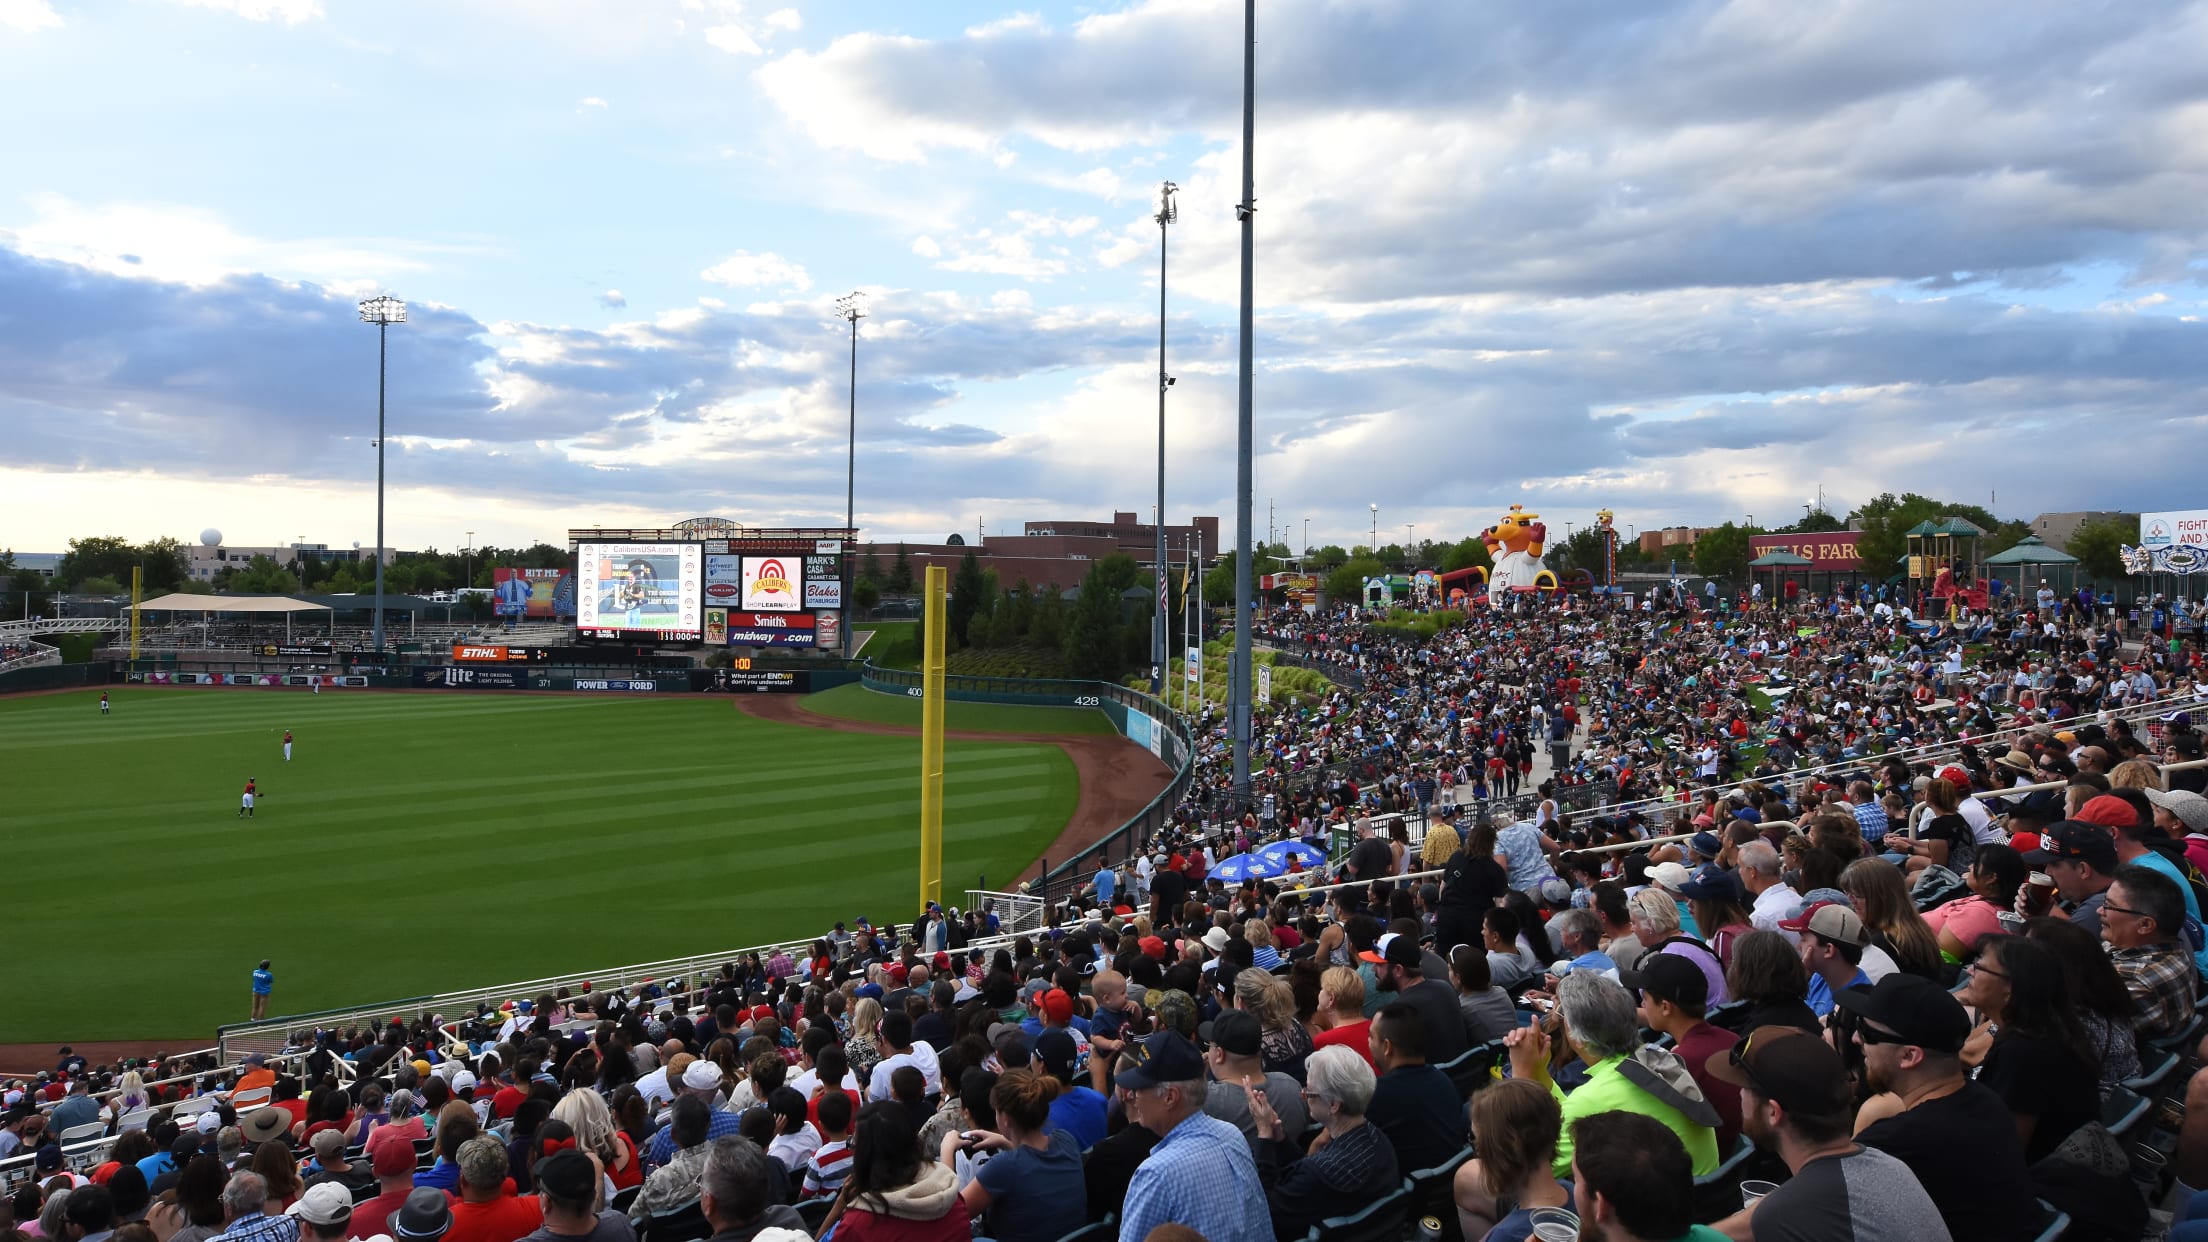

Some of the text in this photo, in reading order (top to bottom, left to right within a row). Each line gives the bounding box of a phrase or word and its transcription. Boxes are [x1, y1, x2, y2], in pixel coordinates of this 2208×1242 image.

[2178, 519, 2208, 531] FIGHT
[2180, 533, 2203, 544] AND
[613, 546, 674, 554] CalibersUSA.com
[1755, 545, 1814, 560] WLS
[806, 556, 835, 565] MARK'S
[525, 568, 543, 577] HIT
[806, 565, 824, 574] CASA
[756, 579, 787, 590] CALIBERS
[807, 584, 839, 597] Blake's
[754, 614, 787, 628] Smith's
[733, 631, 775, 643] midway
[461, 648, 498, 658] STIHL
[129, 672, 142, 681] 340
[443, 667, 474, 686] Lite
[538, 679, 551, 688] 371
[576, 681, 608, 690] POWER
[629, 681, 653, 690] FORD
[907, 687, 923, 697] 400
[1074, 696, 1099, 706] 428
